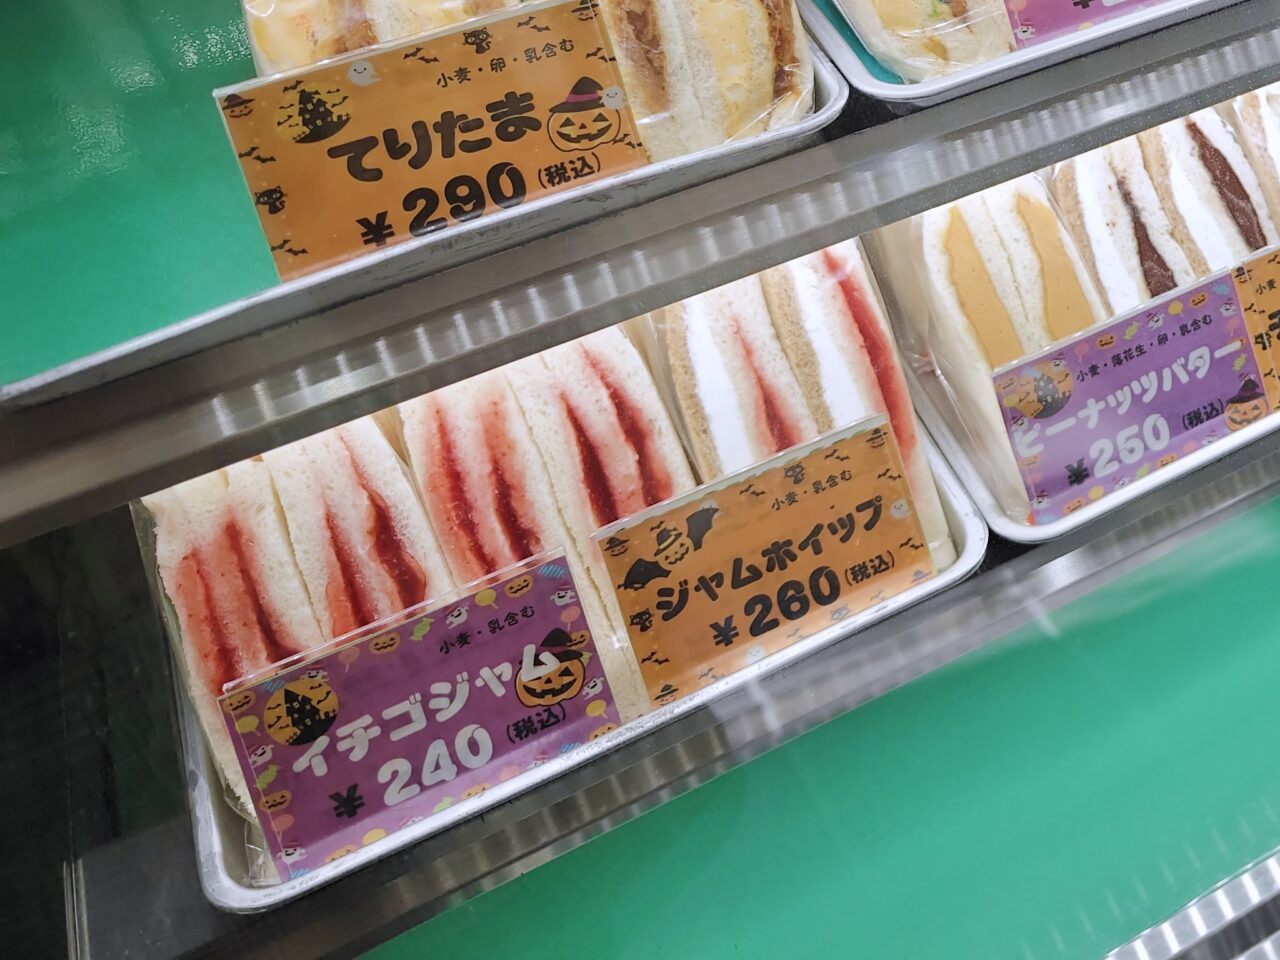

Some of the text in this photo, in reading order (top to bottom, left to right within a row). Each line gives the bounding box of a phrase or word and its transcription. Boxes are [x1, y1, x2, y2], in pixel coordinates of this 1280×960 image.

[437, 38, 575, 89] 小麦・卵・乳含む
[327, 90, 542, 183] てりたま
[356, 161, 528, 247] ¥290
[1013, 339, 1244, 457] ピーナッツバター
[771, 469, 853, 511] 小麦・乳含む
[1065, 411, 1170, 486] ¥250
[656, 495, 883, 622] ジャムホイップ
[439, 604, 536, 656] 小麦・乳含む
[709, 565, 841, 646] ¥260
[292, 643, 561, 777] イチゴジャム
[328, 723, 494, 819] ¥240
